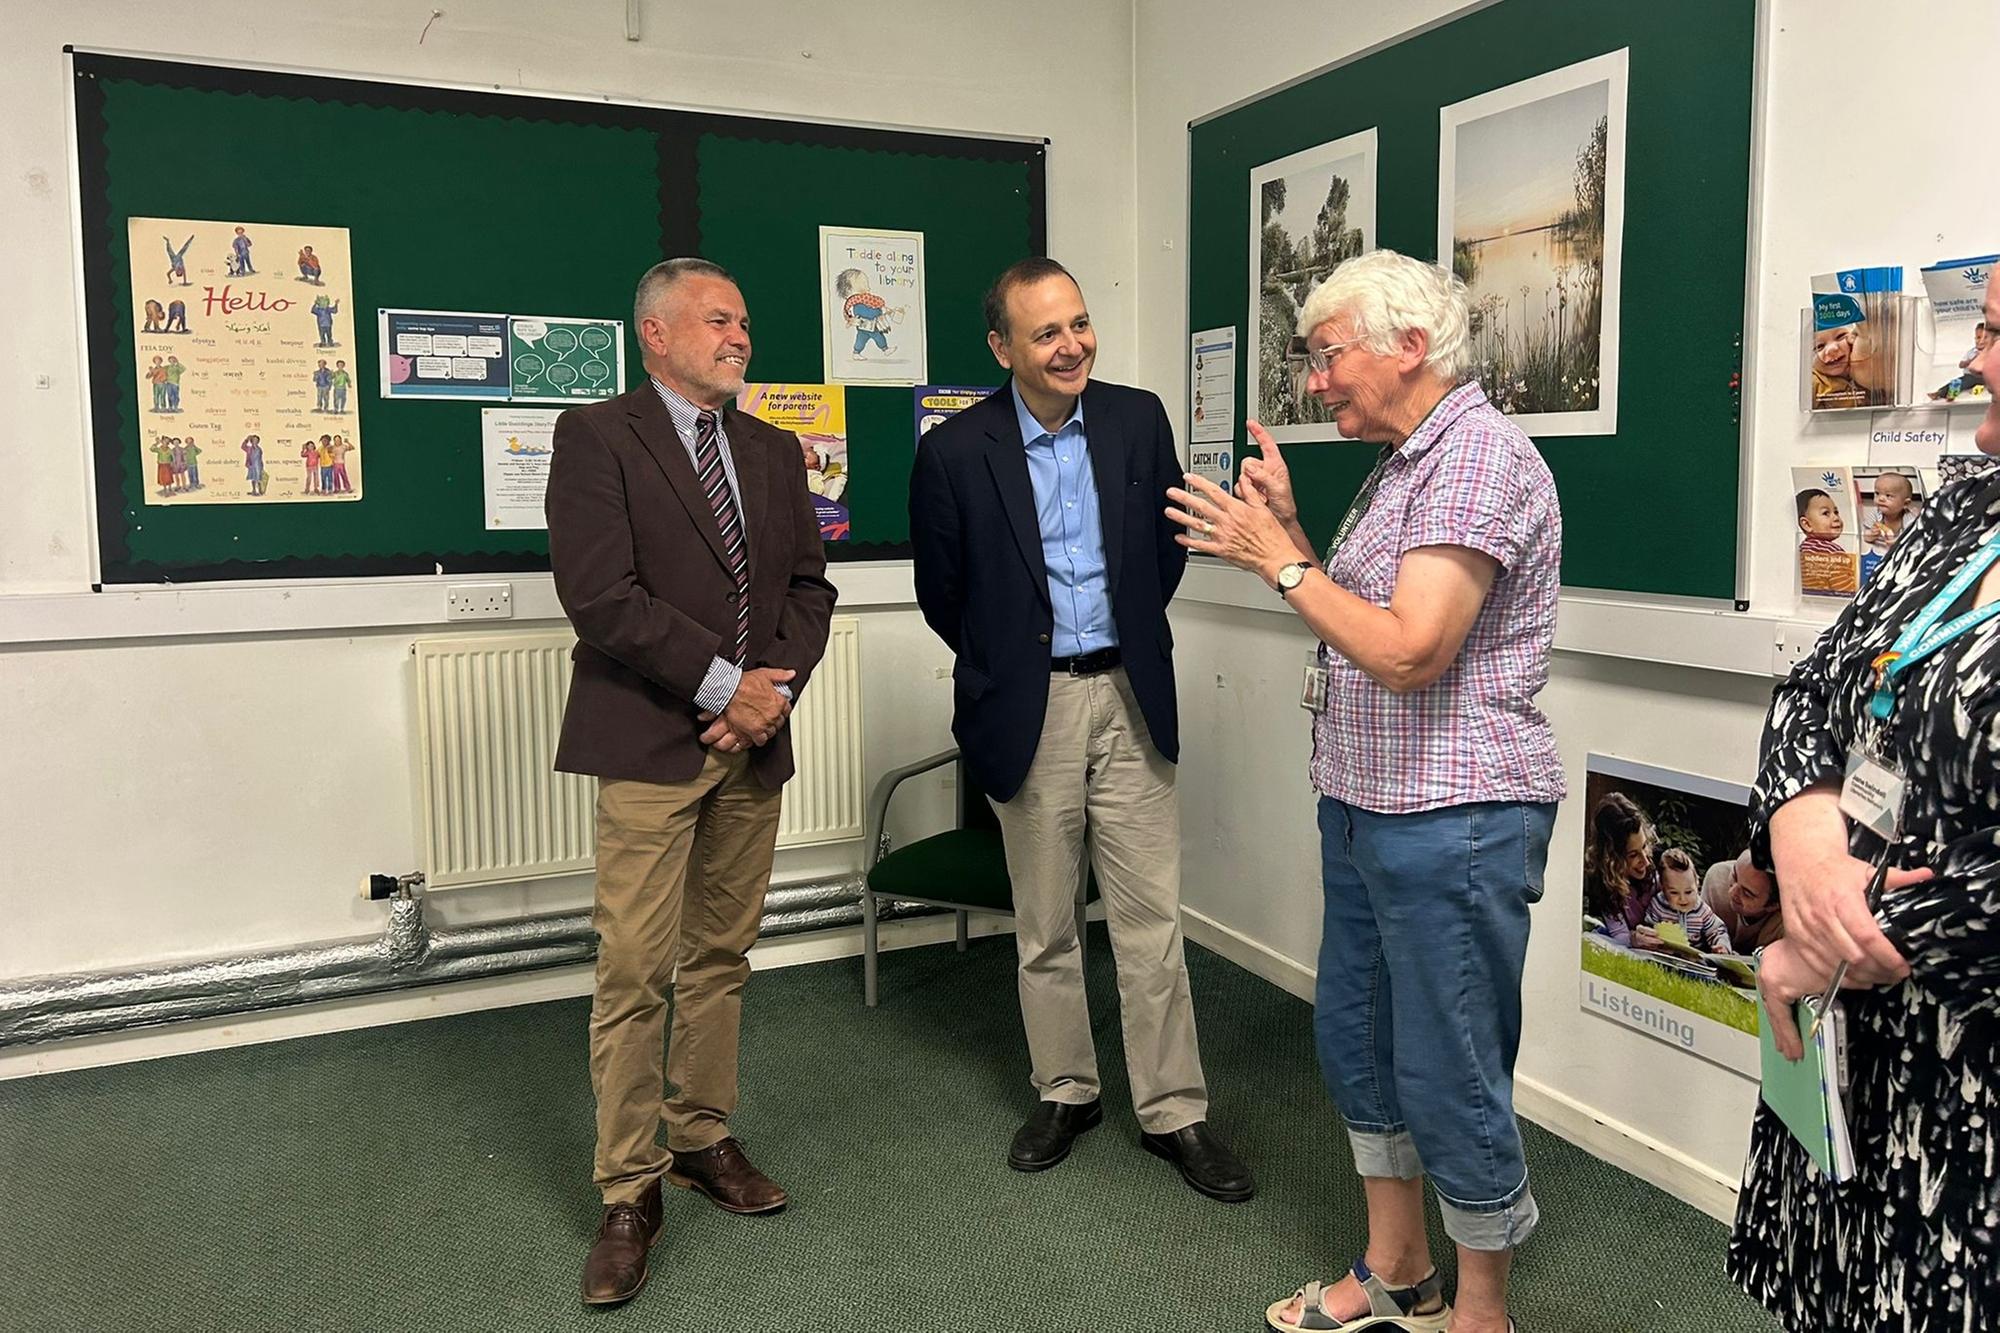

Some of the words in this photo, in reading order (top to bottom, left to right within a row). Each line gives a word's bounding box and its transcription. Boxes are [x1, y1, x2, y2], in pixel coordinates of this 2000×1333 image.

[846, 247, 882, 260] Toddle
[886, 251, 914, 264] along
[874, 261, 886, 272] to
[890, 265, 914, 275] your
[879, 274, 915, 288] library
[202, 284, 297, 317] Hello
[1818, 303, 1828, 312] My
[1829, 302, 1841, 310] first
[1836, 309, 1851, 319] days
[761, 392, 768, 400] A
[790, 393, 822, 401] website
[927, 398, 957, 407] TOOLS
[767, 402, 781, 411] for
[782, 402, 816, 412] parents
[1872, 431, 1901, 443] Child
[1904, 430, 1945, 445] Safety
[1192, 453, 1211, 465] CATCH
[1213, 453, 1219, 465] IT
[1331, 507, 1358, 549] VOLUNTEER
[1908, 605, 1993, 658] COMMUNITY
[1588, 981, 1695, 1048] Listening
